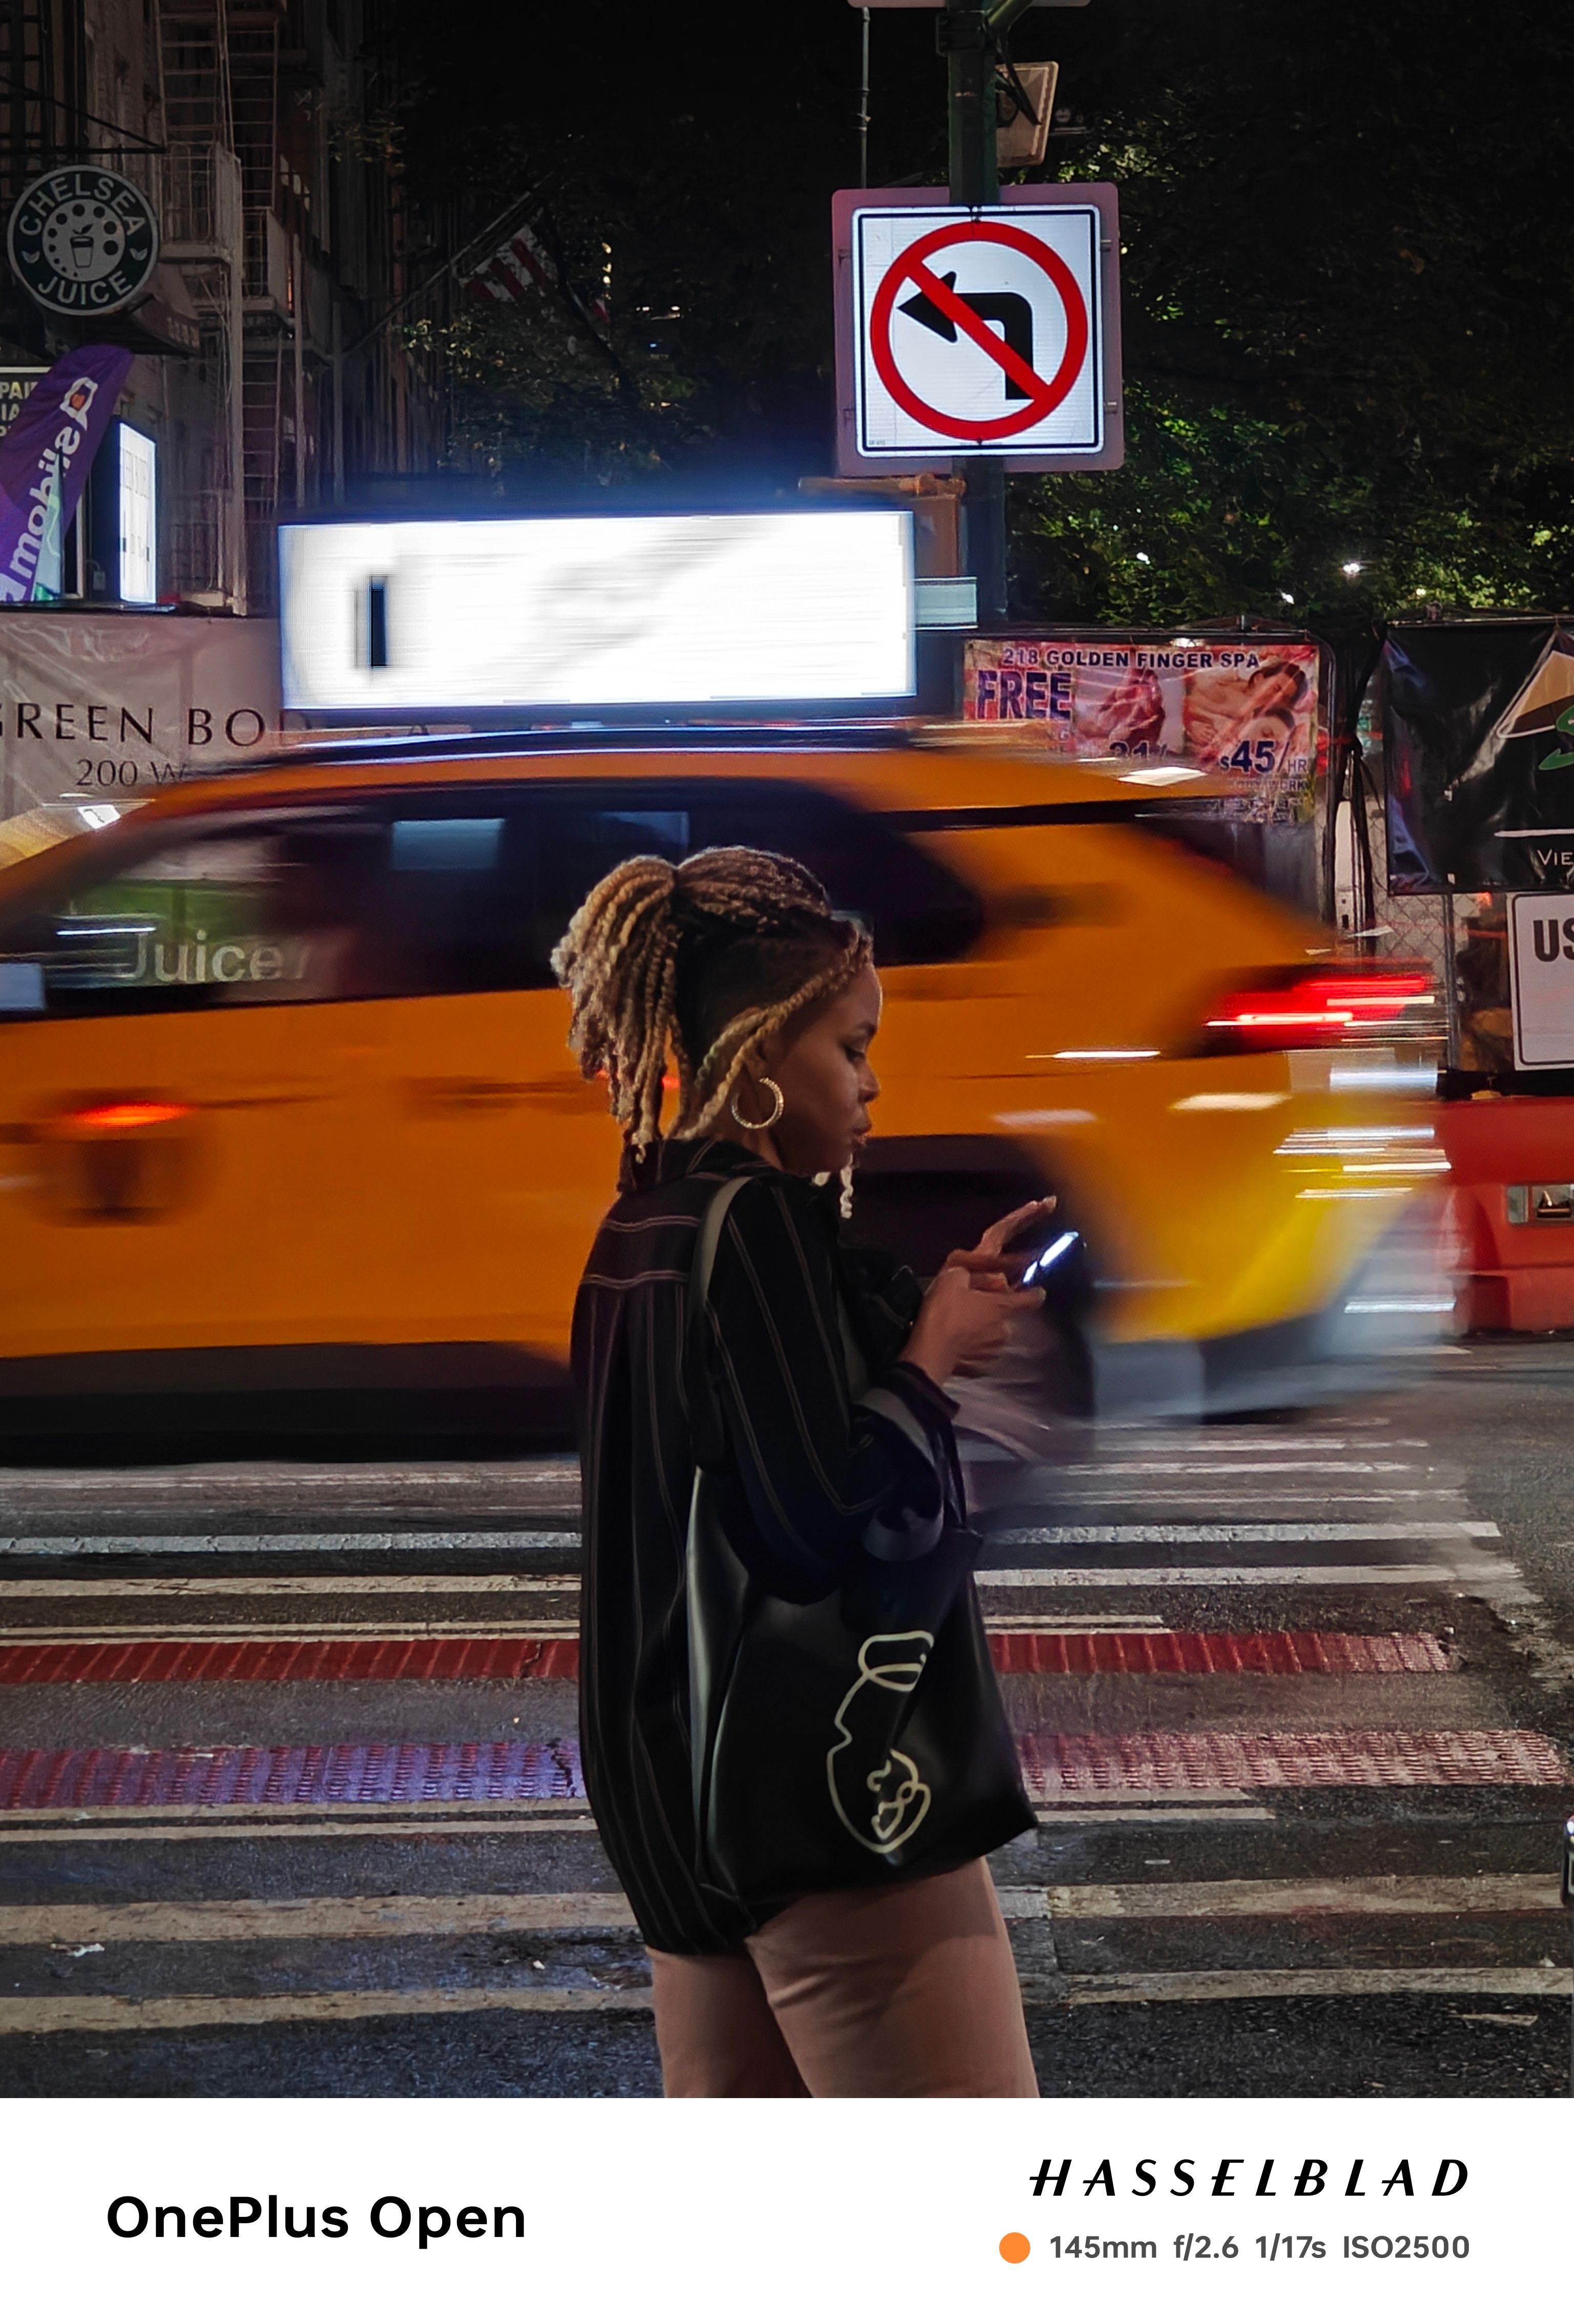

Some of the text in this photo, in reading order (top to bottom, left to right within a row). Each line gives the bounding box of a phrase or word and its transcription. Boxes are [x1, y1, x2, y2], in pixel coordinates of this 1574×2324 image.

[19, 174, 146, 236] CHELSEA
[38, 270, 133, 305] JUICE
[1003, 648, 1260, 668] 218 GOLDEN FINGER SPA
[977, 669, 1071, 720] FREE
[0, 703, 153, 744] REEN
[76, 759, 138, 786] 200
